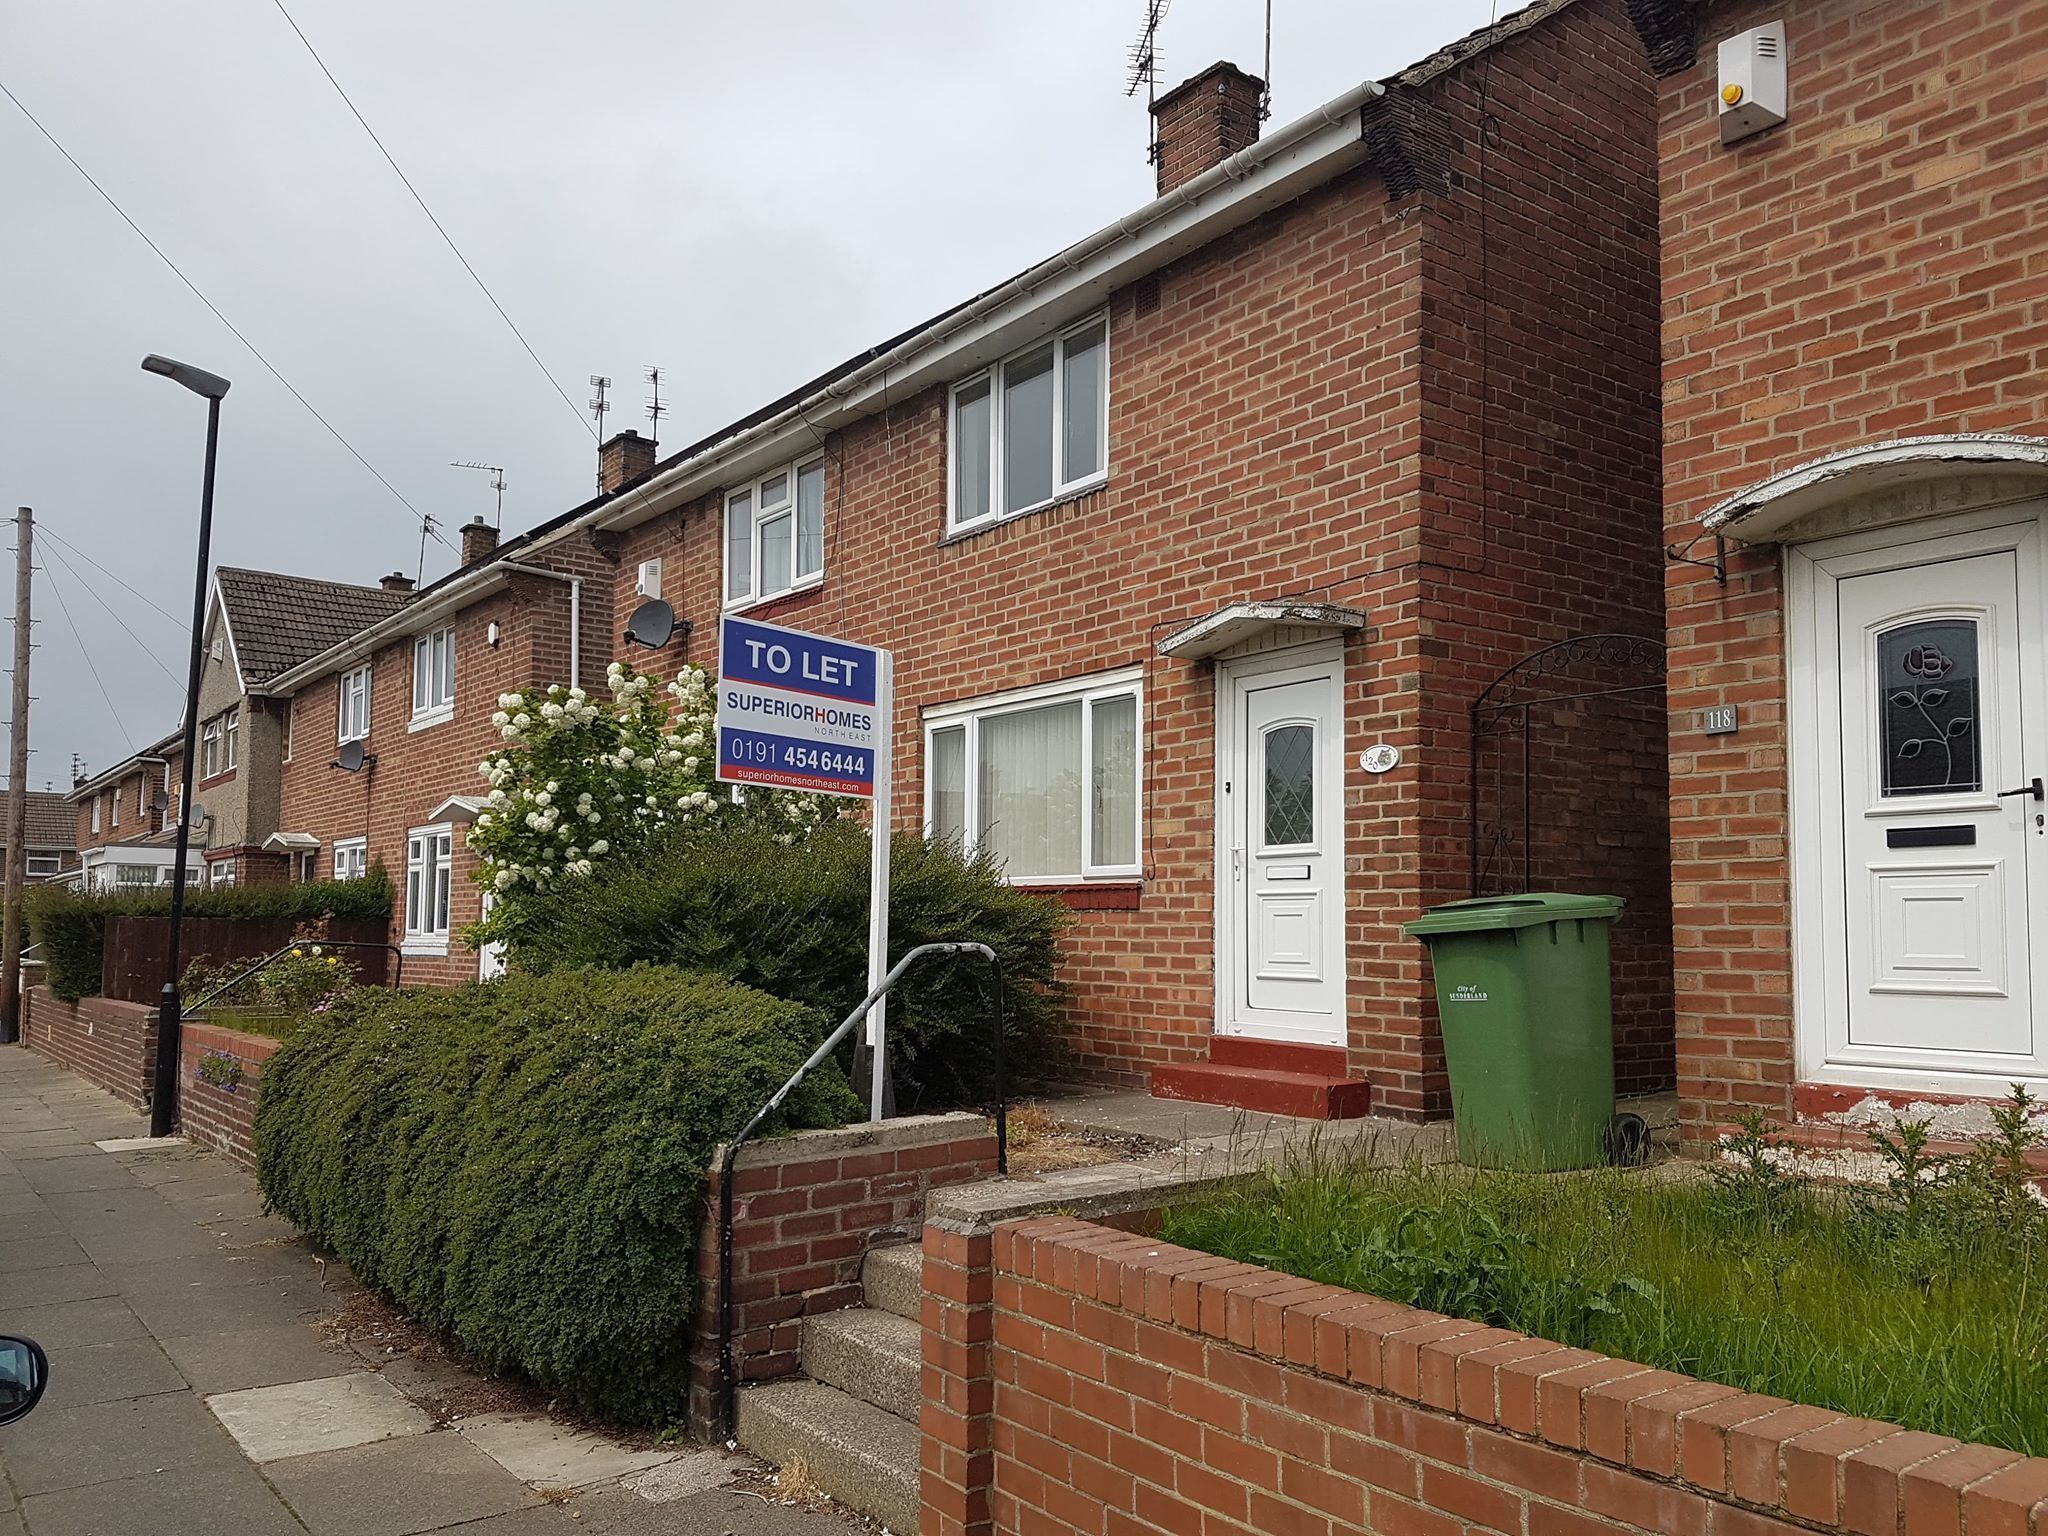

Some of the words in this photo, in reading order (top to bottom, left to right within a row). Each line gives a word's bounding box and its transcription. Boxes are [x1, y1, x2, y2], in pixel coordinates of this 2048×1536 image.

[745, 639, 791, 674] TO
[802, 651, 858, 687] LET
[1709, 709, 1731, 729] 118
[732, 738, 776, 764] 0191
[1364, 753, 1379, 770] 120
[737, 769, 859, 792] superiorhomesnortheast.com
[1457, 985, 1469, 993] City
[1469, 984, 1478, 993] of
